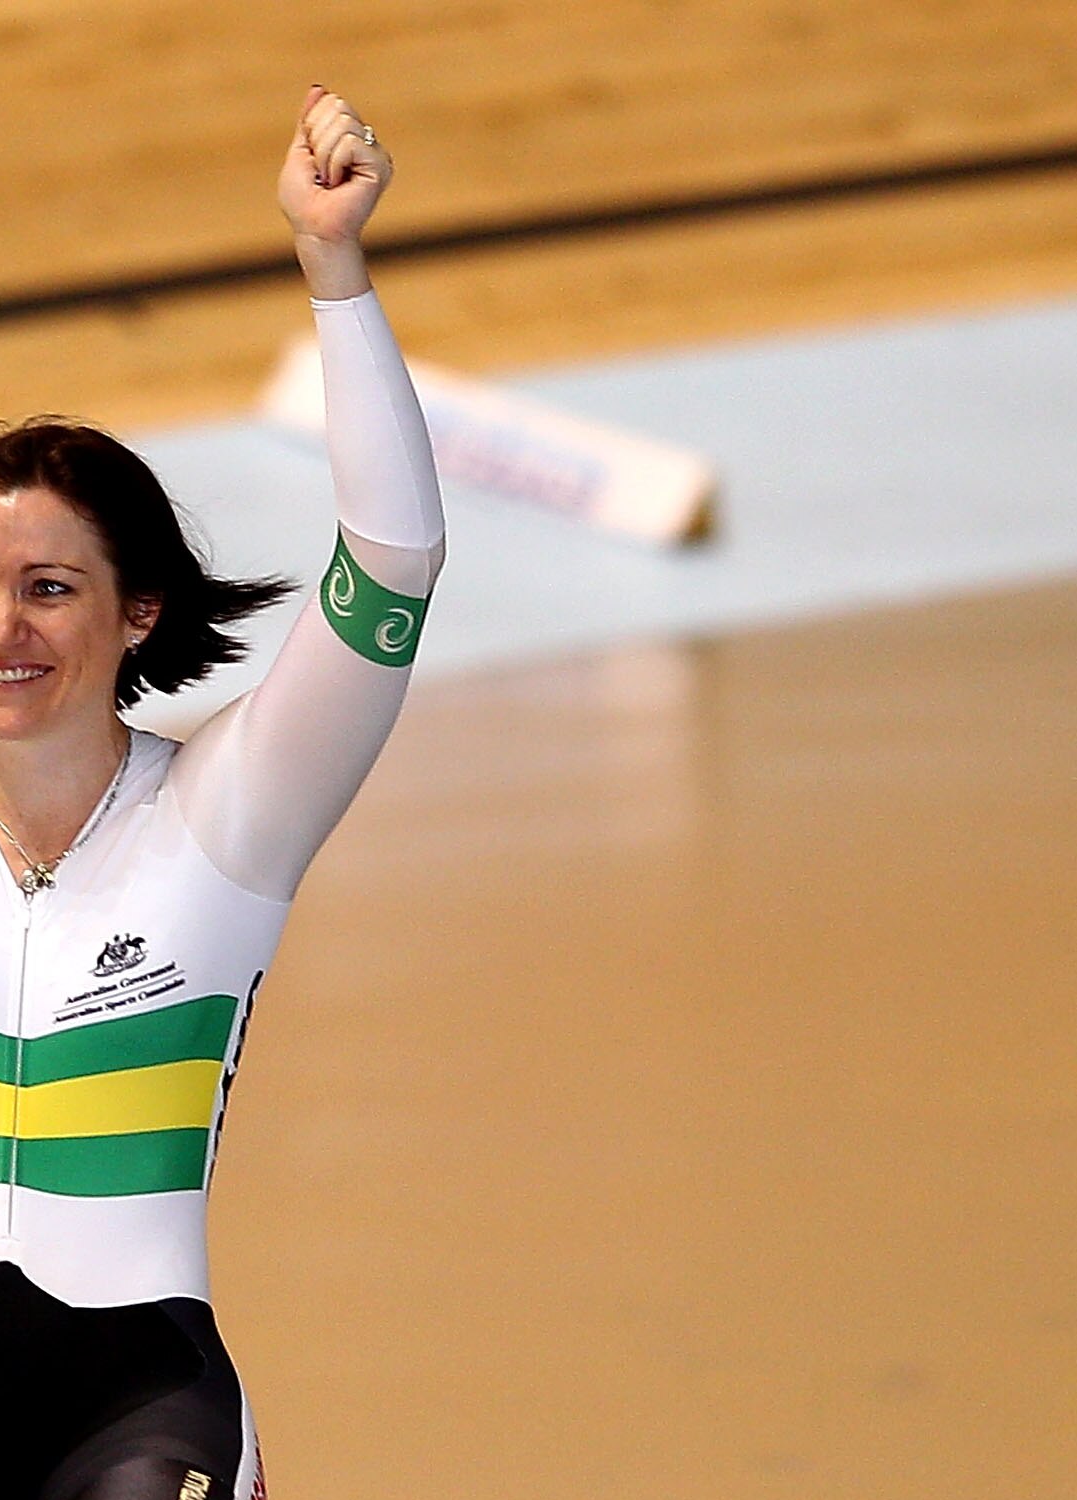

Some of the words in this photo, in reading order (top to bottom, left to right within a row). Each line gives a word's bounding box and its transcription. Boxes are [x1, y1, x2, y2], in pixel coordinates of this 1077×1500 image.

[64, 984, 118, 1005] Australian
[120, 960, 177, 988] Government
[52, 1006, 103, 1025] Australian
